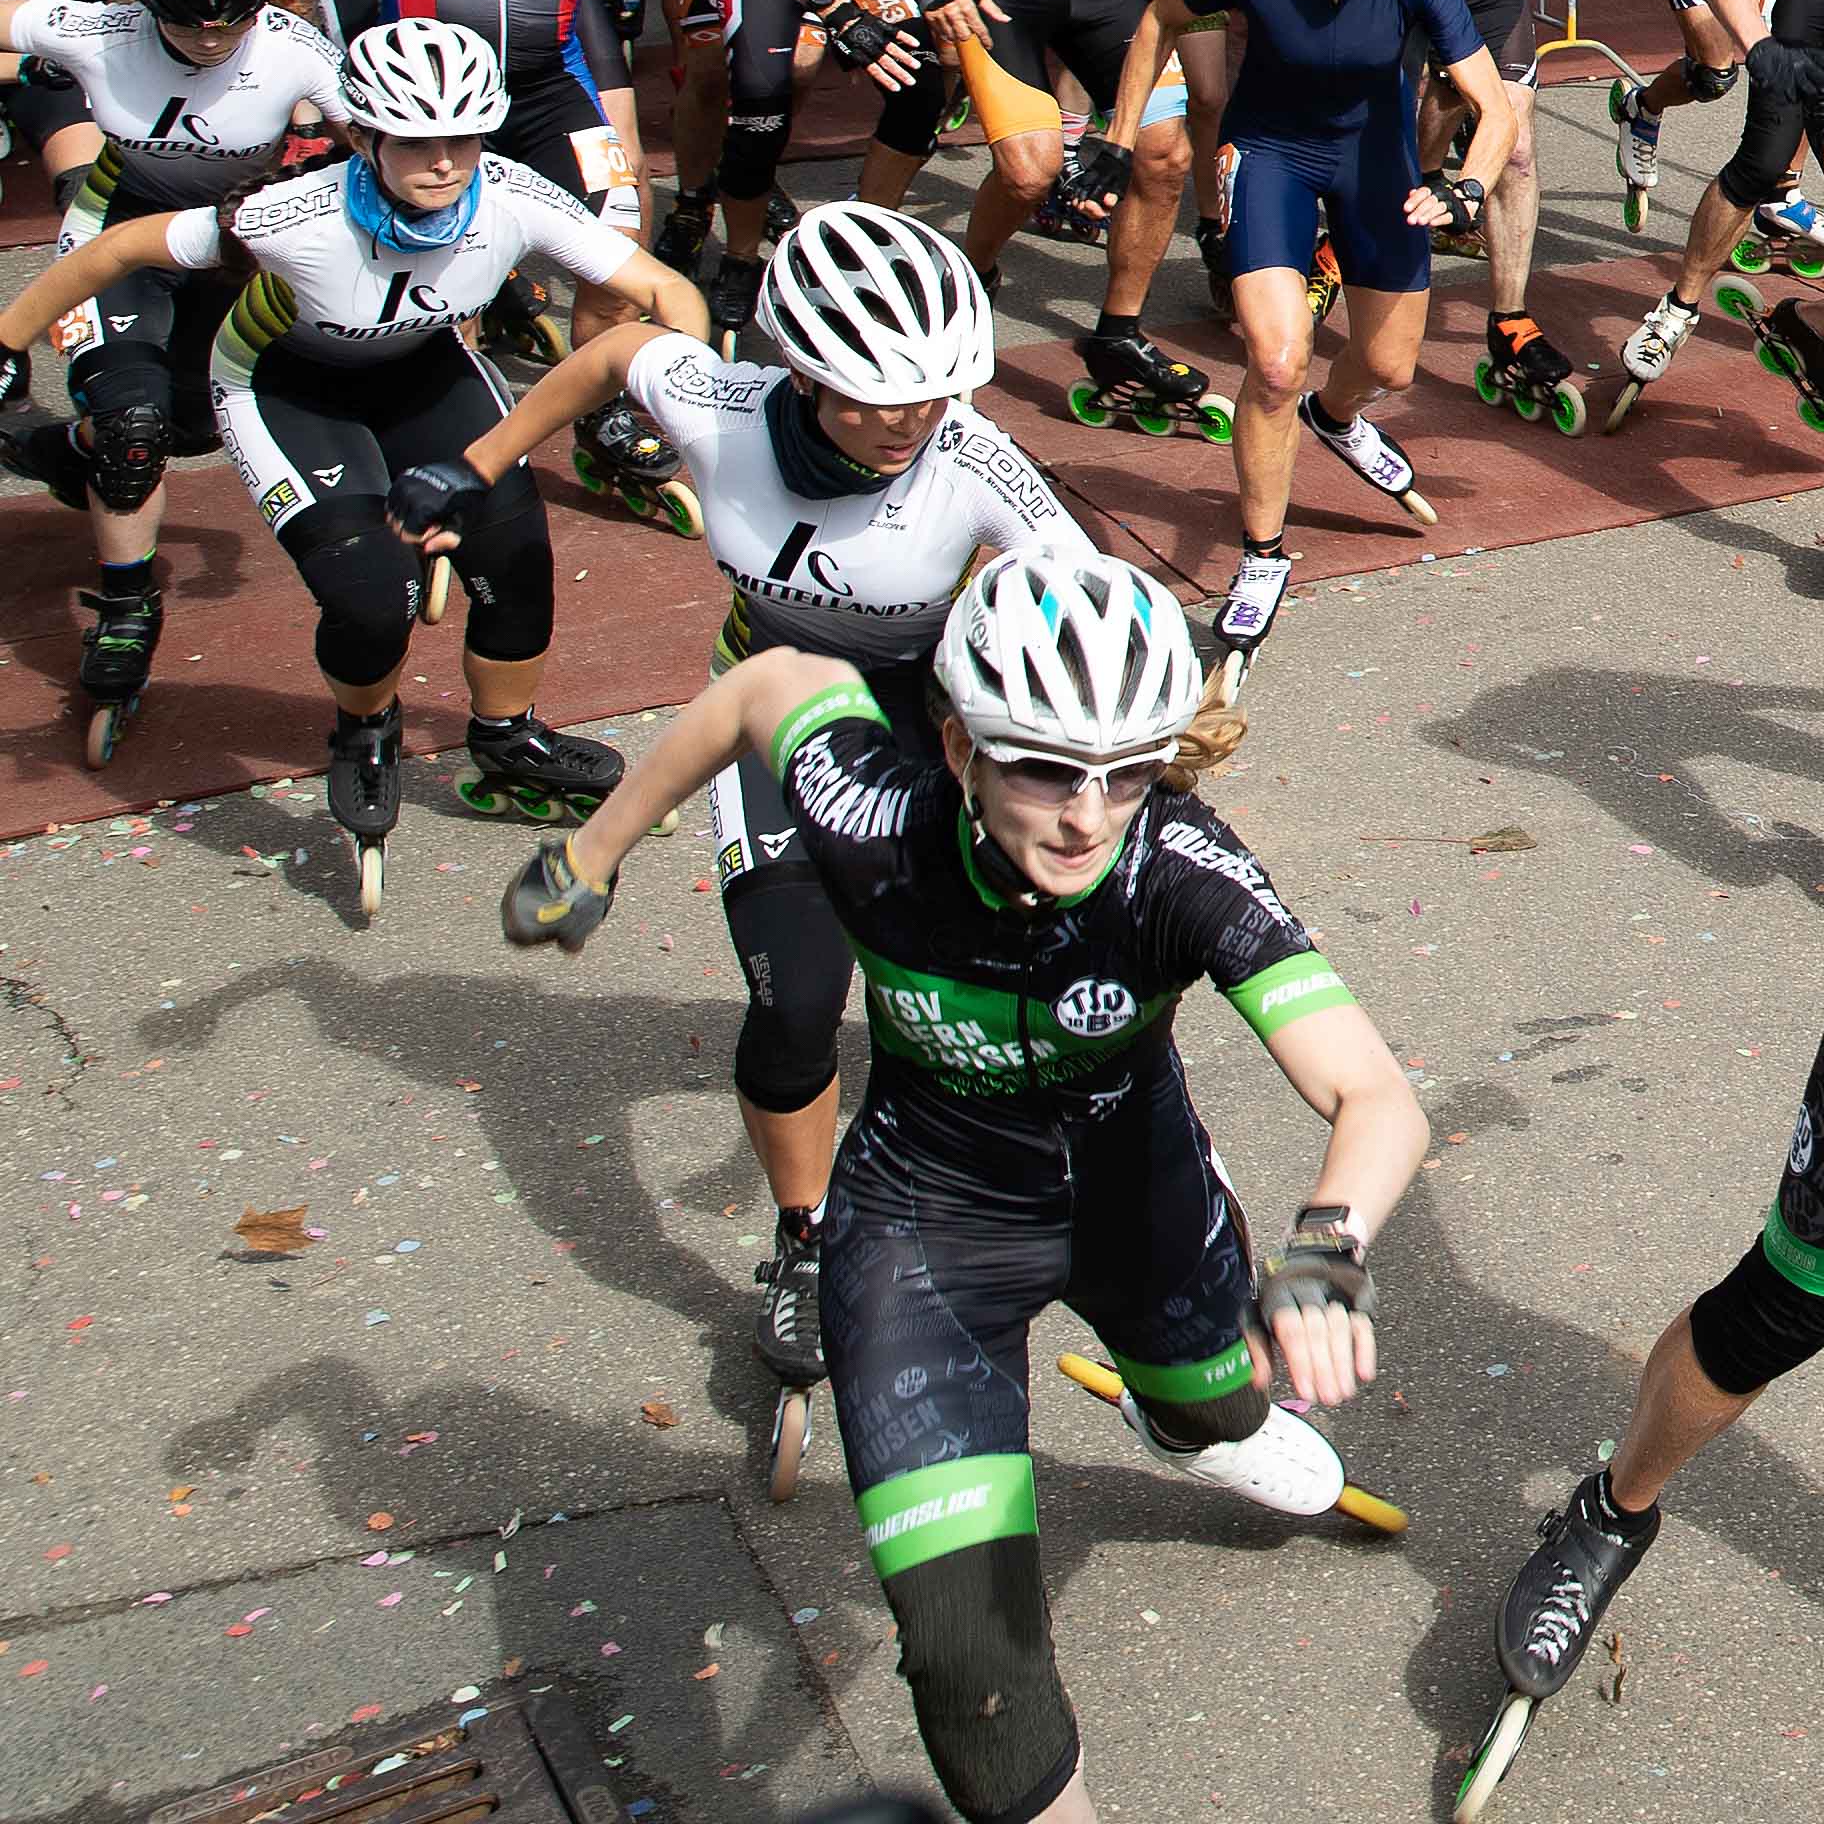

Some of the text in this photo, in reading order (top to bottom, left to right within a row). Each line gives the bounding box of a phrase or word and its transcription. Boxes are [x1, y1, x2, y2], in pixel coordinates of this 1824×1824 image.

[115, 136, 265, 160] MITTELLAND
[238, 182, 338, 231] BONT
[507, 166, 588, 216] BONT
[959, 433, 1057, 520] BONT
[731, 573, 910, 617] MITTELLAND
[877, 984, 943, 1024] TSV
